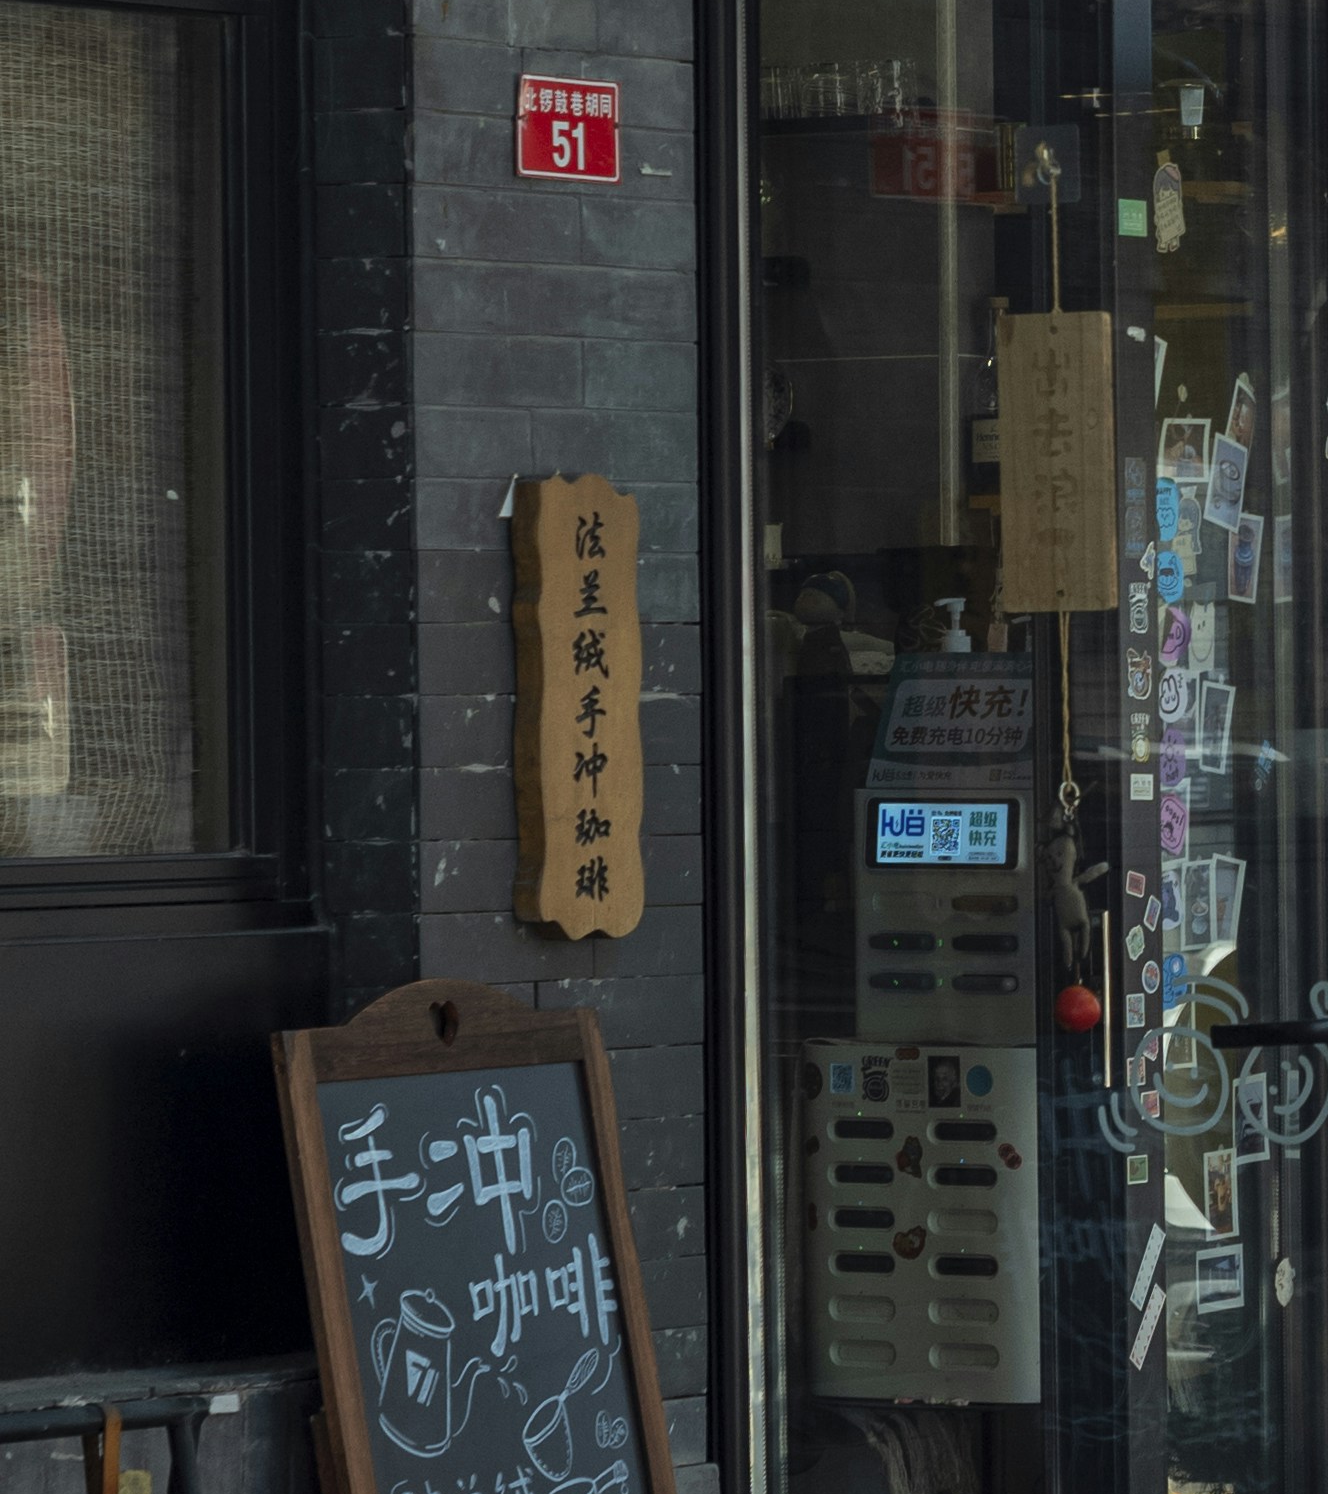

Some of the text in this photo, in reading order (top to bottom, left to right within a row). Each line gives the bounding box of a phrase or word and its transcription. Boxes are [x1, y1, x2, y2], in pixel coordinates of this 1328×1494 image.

[525, 86, 613, 119] 北锣鼓巷胡同
[551, 120, 586, 171] 51
[891, 725, 1023, 747] 免费充电10分钟
[969, 811, 998, 828] 超级
[968, 830, 998, 847] 快充
[340, 1092, 535, 1259] 手冲
[469, 1232, 618, 1358] 咖啡
